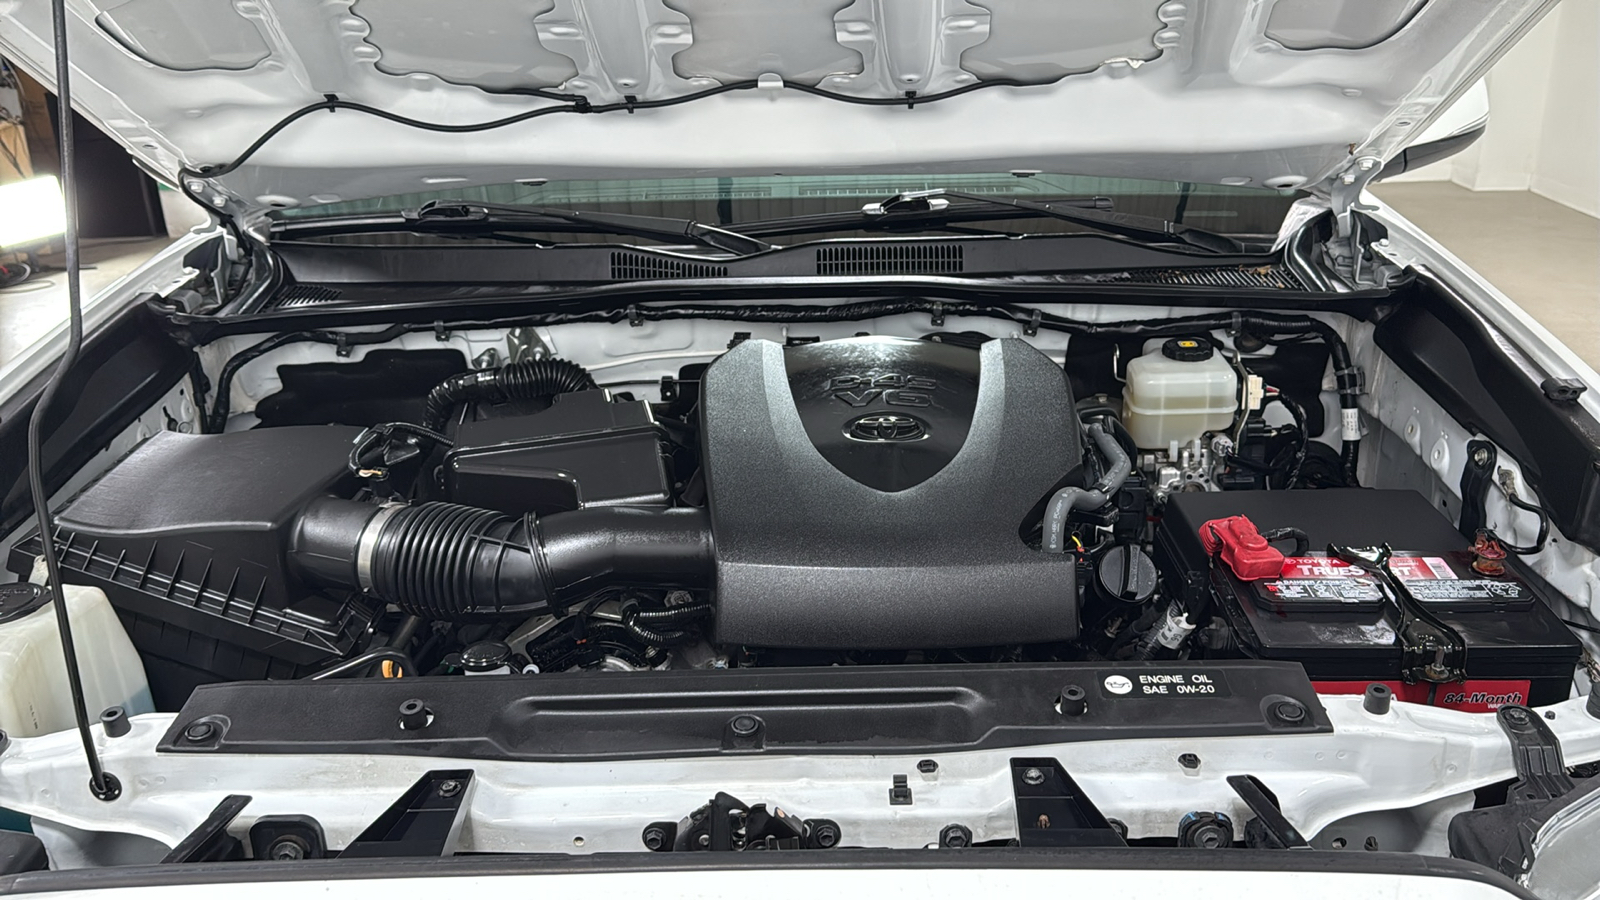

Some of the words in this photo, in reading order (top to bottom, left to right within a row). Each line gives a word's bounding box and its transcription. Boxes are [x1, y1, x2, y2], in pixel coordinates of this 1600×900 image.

[833, 389, 931, 408] V6
[1139, 675, 1185, 684] ENGINE
[1191, 674, 1213, 683] OIL
[1142, 685, 1168, 694] SAE
[1176, 685, 1215, 694] 0W-20
[1444, 692, 1522, 704] 84-Month
